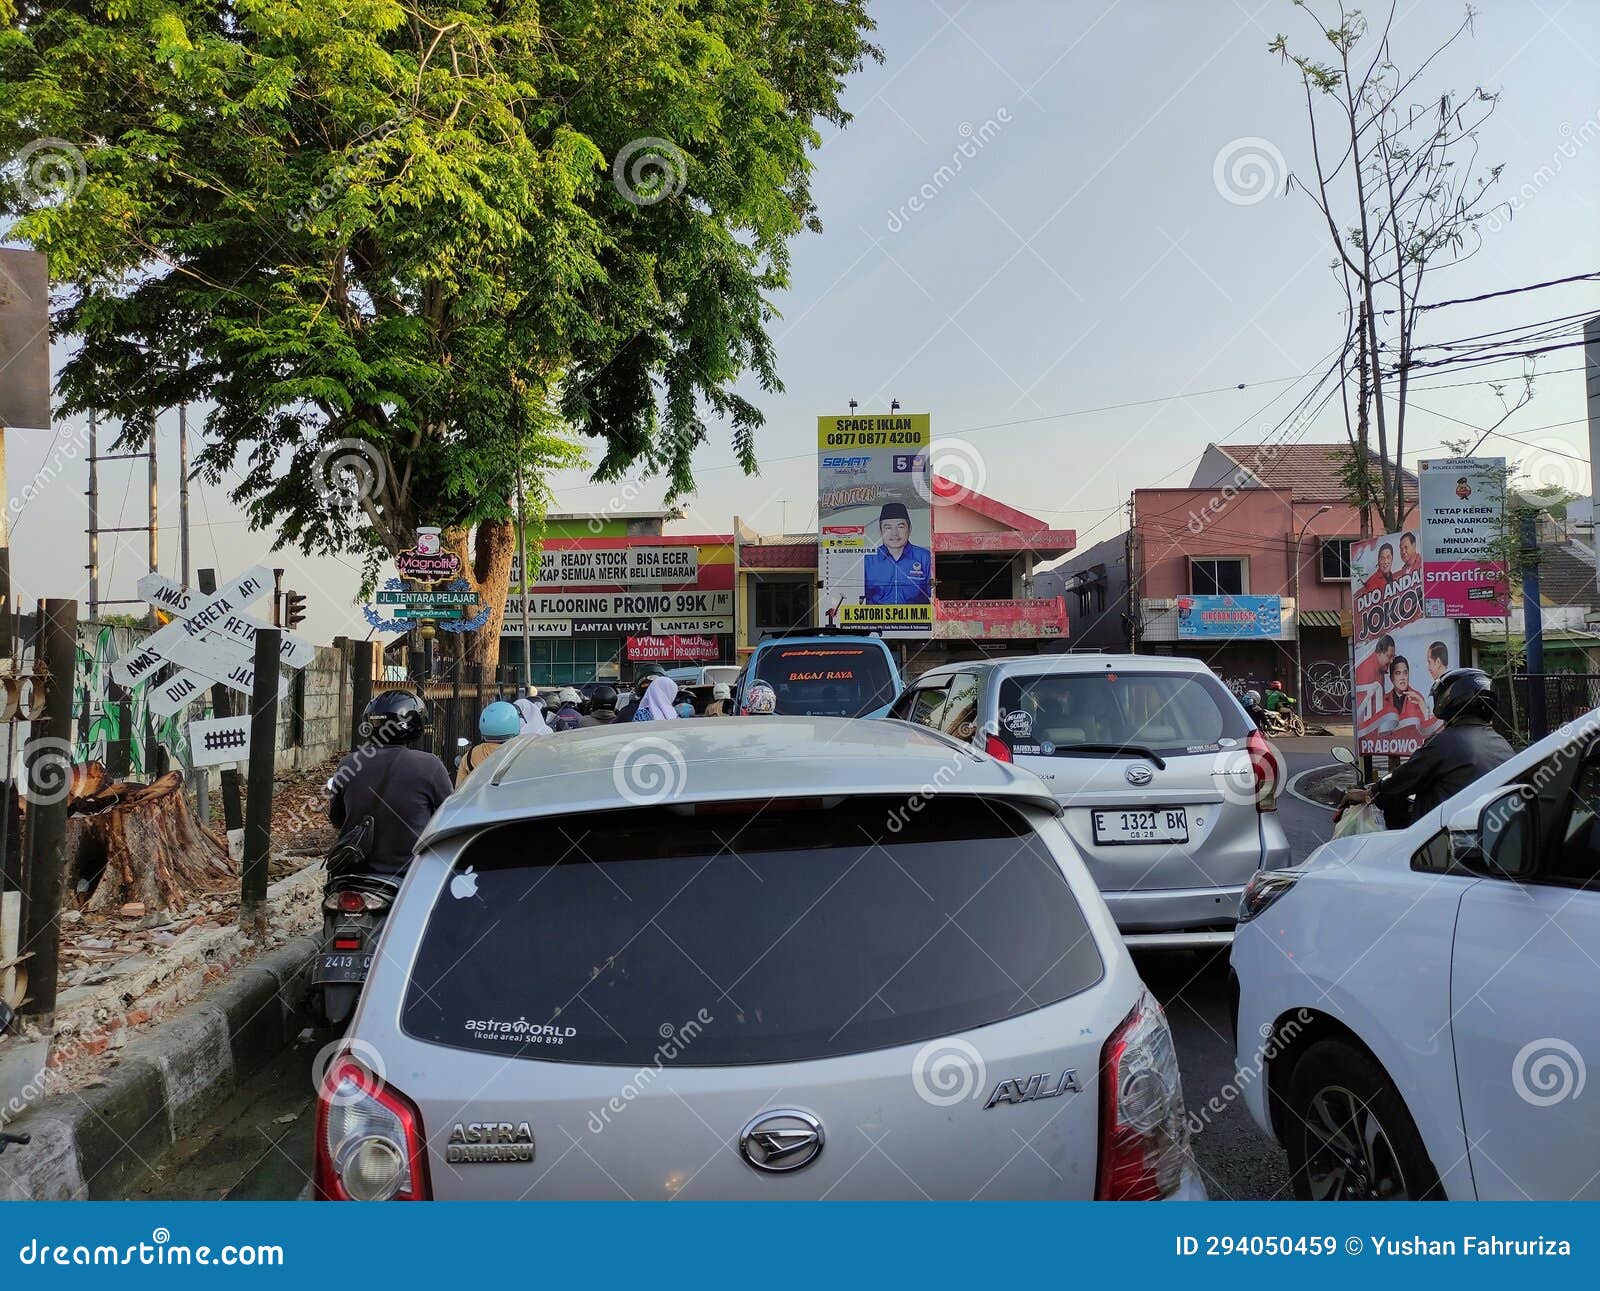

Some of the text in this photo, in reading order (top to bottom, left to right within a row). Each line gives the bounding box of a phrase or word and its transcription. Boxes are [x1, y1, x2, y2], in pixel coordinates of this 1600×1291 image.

[837, 418, 911, 431] SPACE IKLAN
[827, 432, 921, 445] 0877 0877 4200
[897, 457, 907, 471] 5
[561, 553, 592, 567] READY
[595, 552, 628, 566] STOCK
[636, 552, 659, 565] BISA
[662, 552, 688, 565] ECER
[561, 567, 596, 581] SEMUA
[598, 566, 628, 580] MERK
[630, 567, 649, 578] BELI
[651, 566, 696, 578] LEMBARAN
[153, 586, 191, 610] AWAS
[380, 593, 476, 603] JL. TENTARA PELAJAR
[540, 597, 608, 614] FLOORING
[613, 596, 671, 614] PROMO
[676, 595, 707, 612] 99K
[1357, 588, 1381, 612] DUO
[844, 608, 852, 620] H.
[853, 607, 883, 620] SATORI
[910, 607, 930, 620] M.M.
[1359, 585, 1424, 641] JOKO
[126, 577, 261, 678] AWAS KERETA API
[538, 624, 567, 632] KAYU
[574, 622, 649, 632] LANTAI VINYL
[660, 621, 724, 630] LANTAI SPC
[637, 636, 665, 646] VYNIL
[789, 671, 854, 680] BAGAS RAYA
[166, 678, 196, 703] DUA
[1096, 812, 1186, 831] E 1321 BK
[325, 956, 353, 968] 2413
[474, 1031, 564, 1045] (kode area) 500 898
[983, 1068, 1082, 1111] AYLA
[448, 1121, 534, 1144] ASTRA
[448, 1144, 533, 1162] DAIHATSU
